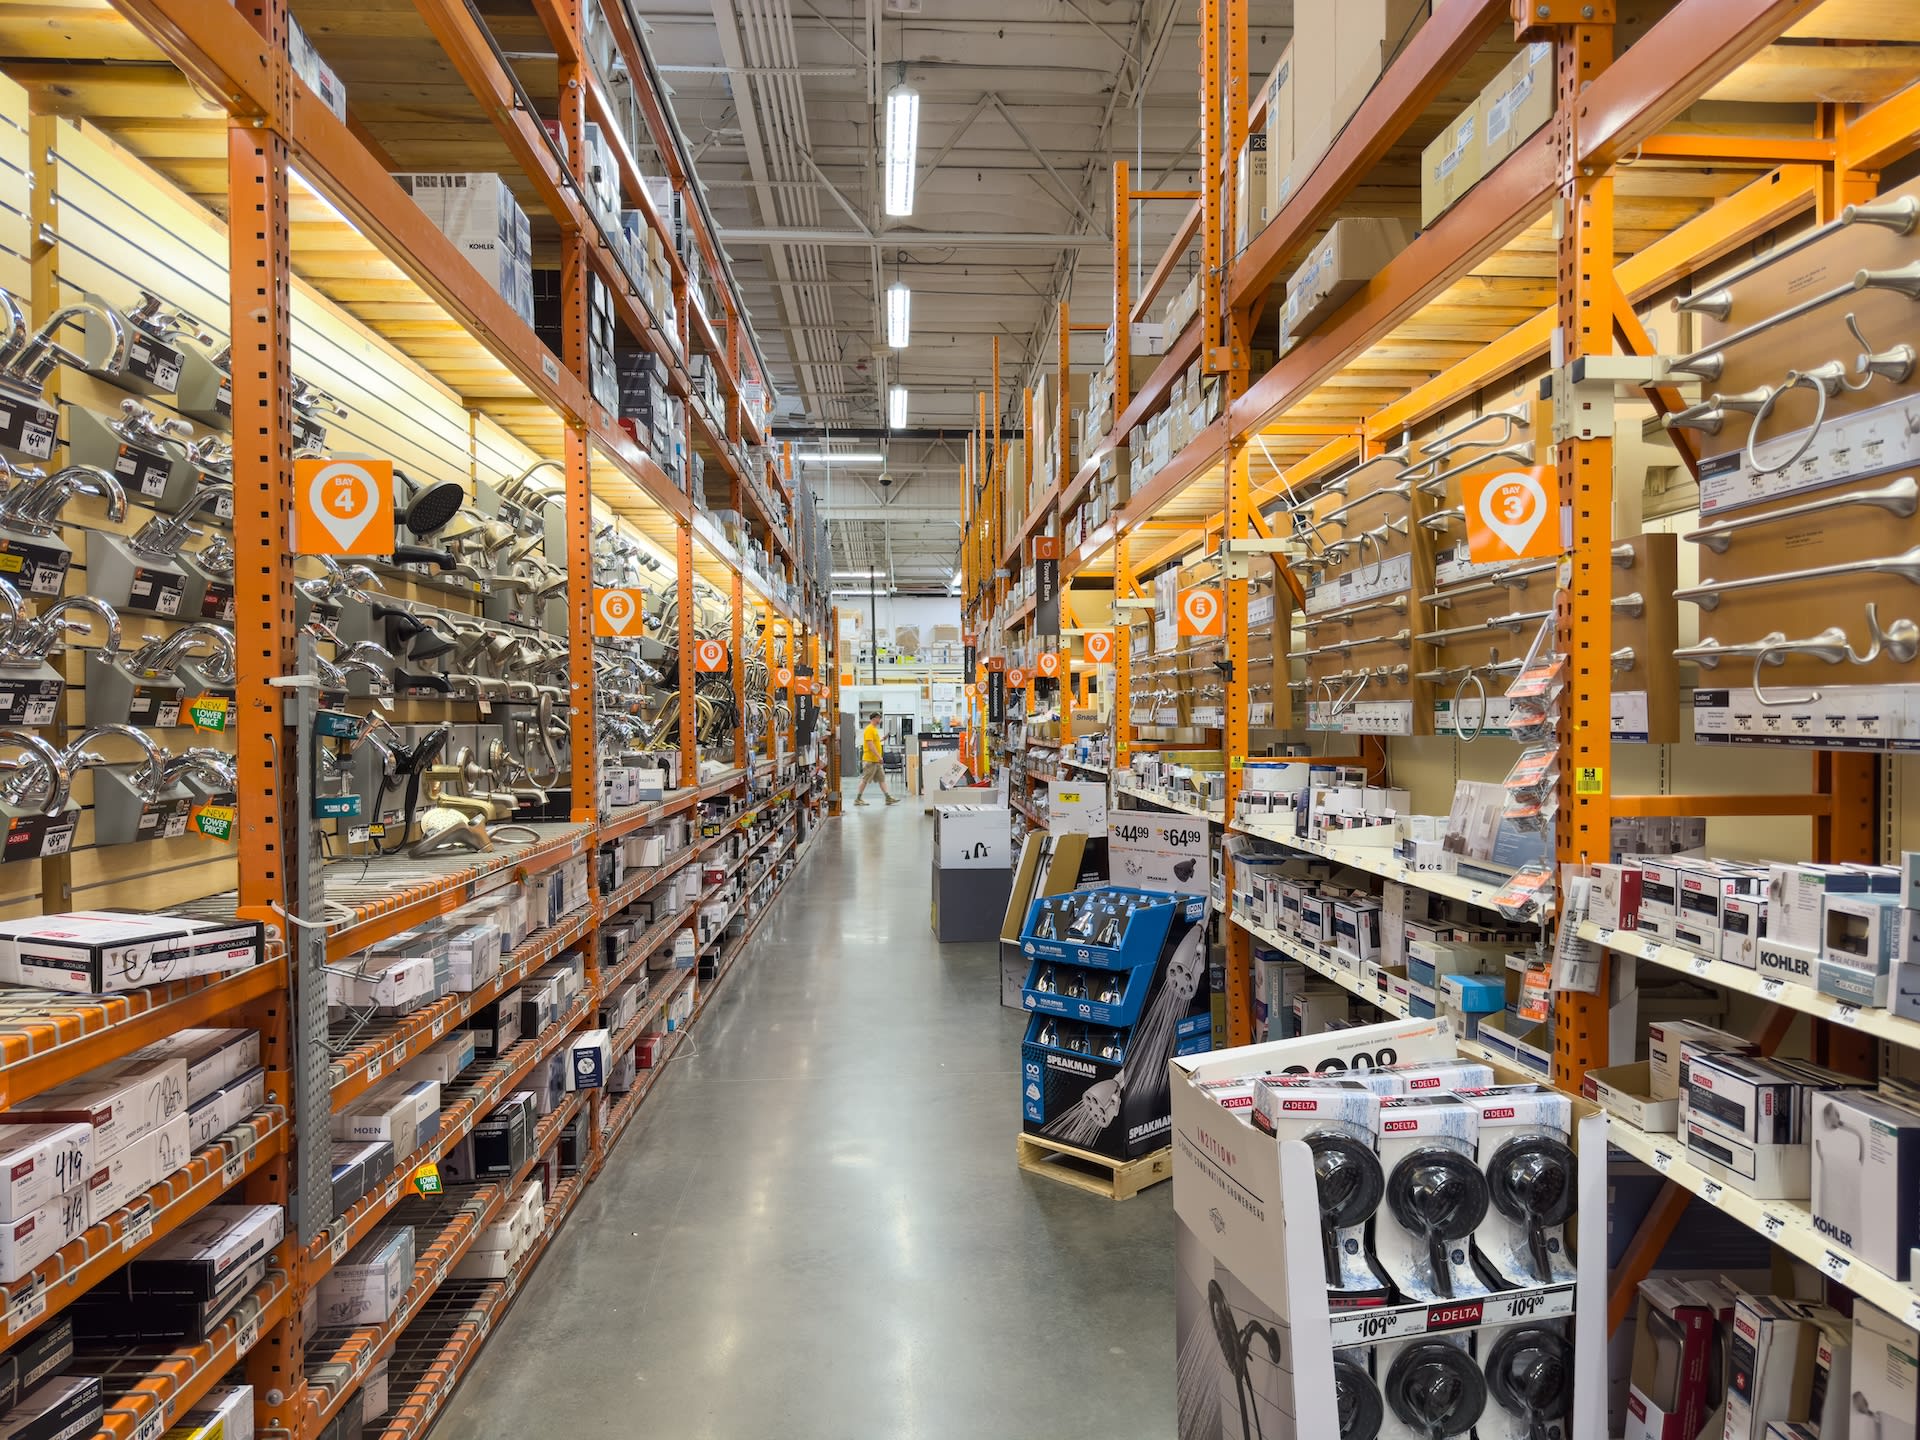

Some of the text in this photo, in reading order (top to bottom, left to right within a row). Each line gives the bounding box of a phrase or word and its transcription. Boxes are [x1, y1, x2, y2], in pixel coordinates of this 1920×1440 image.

[335, 478, 354, 486] BAY
[1502, 486, 1521, 495] BAY
[334, 490, 354, 512] 4
[1503, 496, 1524, 520] 3
[1043, 561, 1051, 601] Towel Bars
[612, 604, 623, 615] 6
[1196, 604, 1206, 615] 5
[1095, 640, 1102, 650] 7
[708, 650, 714, 658] 8
[200, 700, 221, 709] NEW
[196, 709, 222, 720] LOWER
[199, 717, 218, 727] PRICE
[205, 808, 228, 818] NEW
[202, 816, 228, 828] LOWER
[204, 824, 224, 835] PRICE
[14, 834, 29, 843] DELTA
[1188, 904, 1202, 914] ICON
[1760, 951, 1809, 976] KOHLER
[1046, 1054, 1097, 1075] SPEAKMAN
[1418, 1078, 1440, 1088] DELTA
[1229, 1098, 1252, 1108] DELTA
[1291, 1102, 1316, 1110] DELTA
[1490, 1108, 1514, 1118] DELTA
[354, 1127, 382, 1135] MOEN
[1392, 1122, 1417, 1130] DELTA
[420, 1167, 435, 1176] NEW
[419, 1175, 438, 1186] LOWER
[422, 1181, 437, 1190] PRICE
[1813, 1214, 1852, 1248] KOHLER
[1442, 1308, 1480, 1322] DELTA
[0, 1380, 20, 1398] andle
[84, 1410, 100, 1427] BAY
